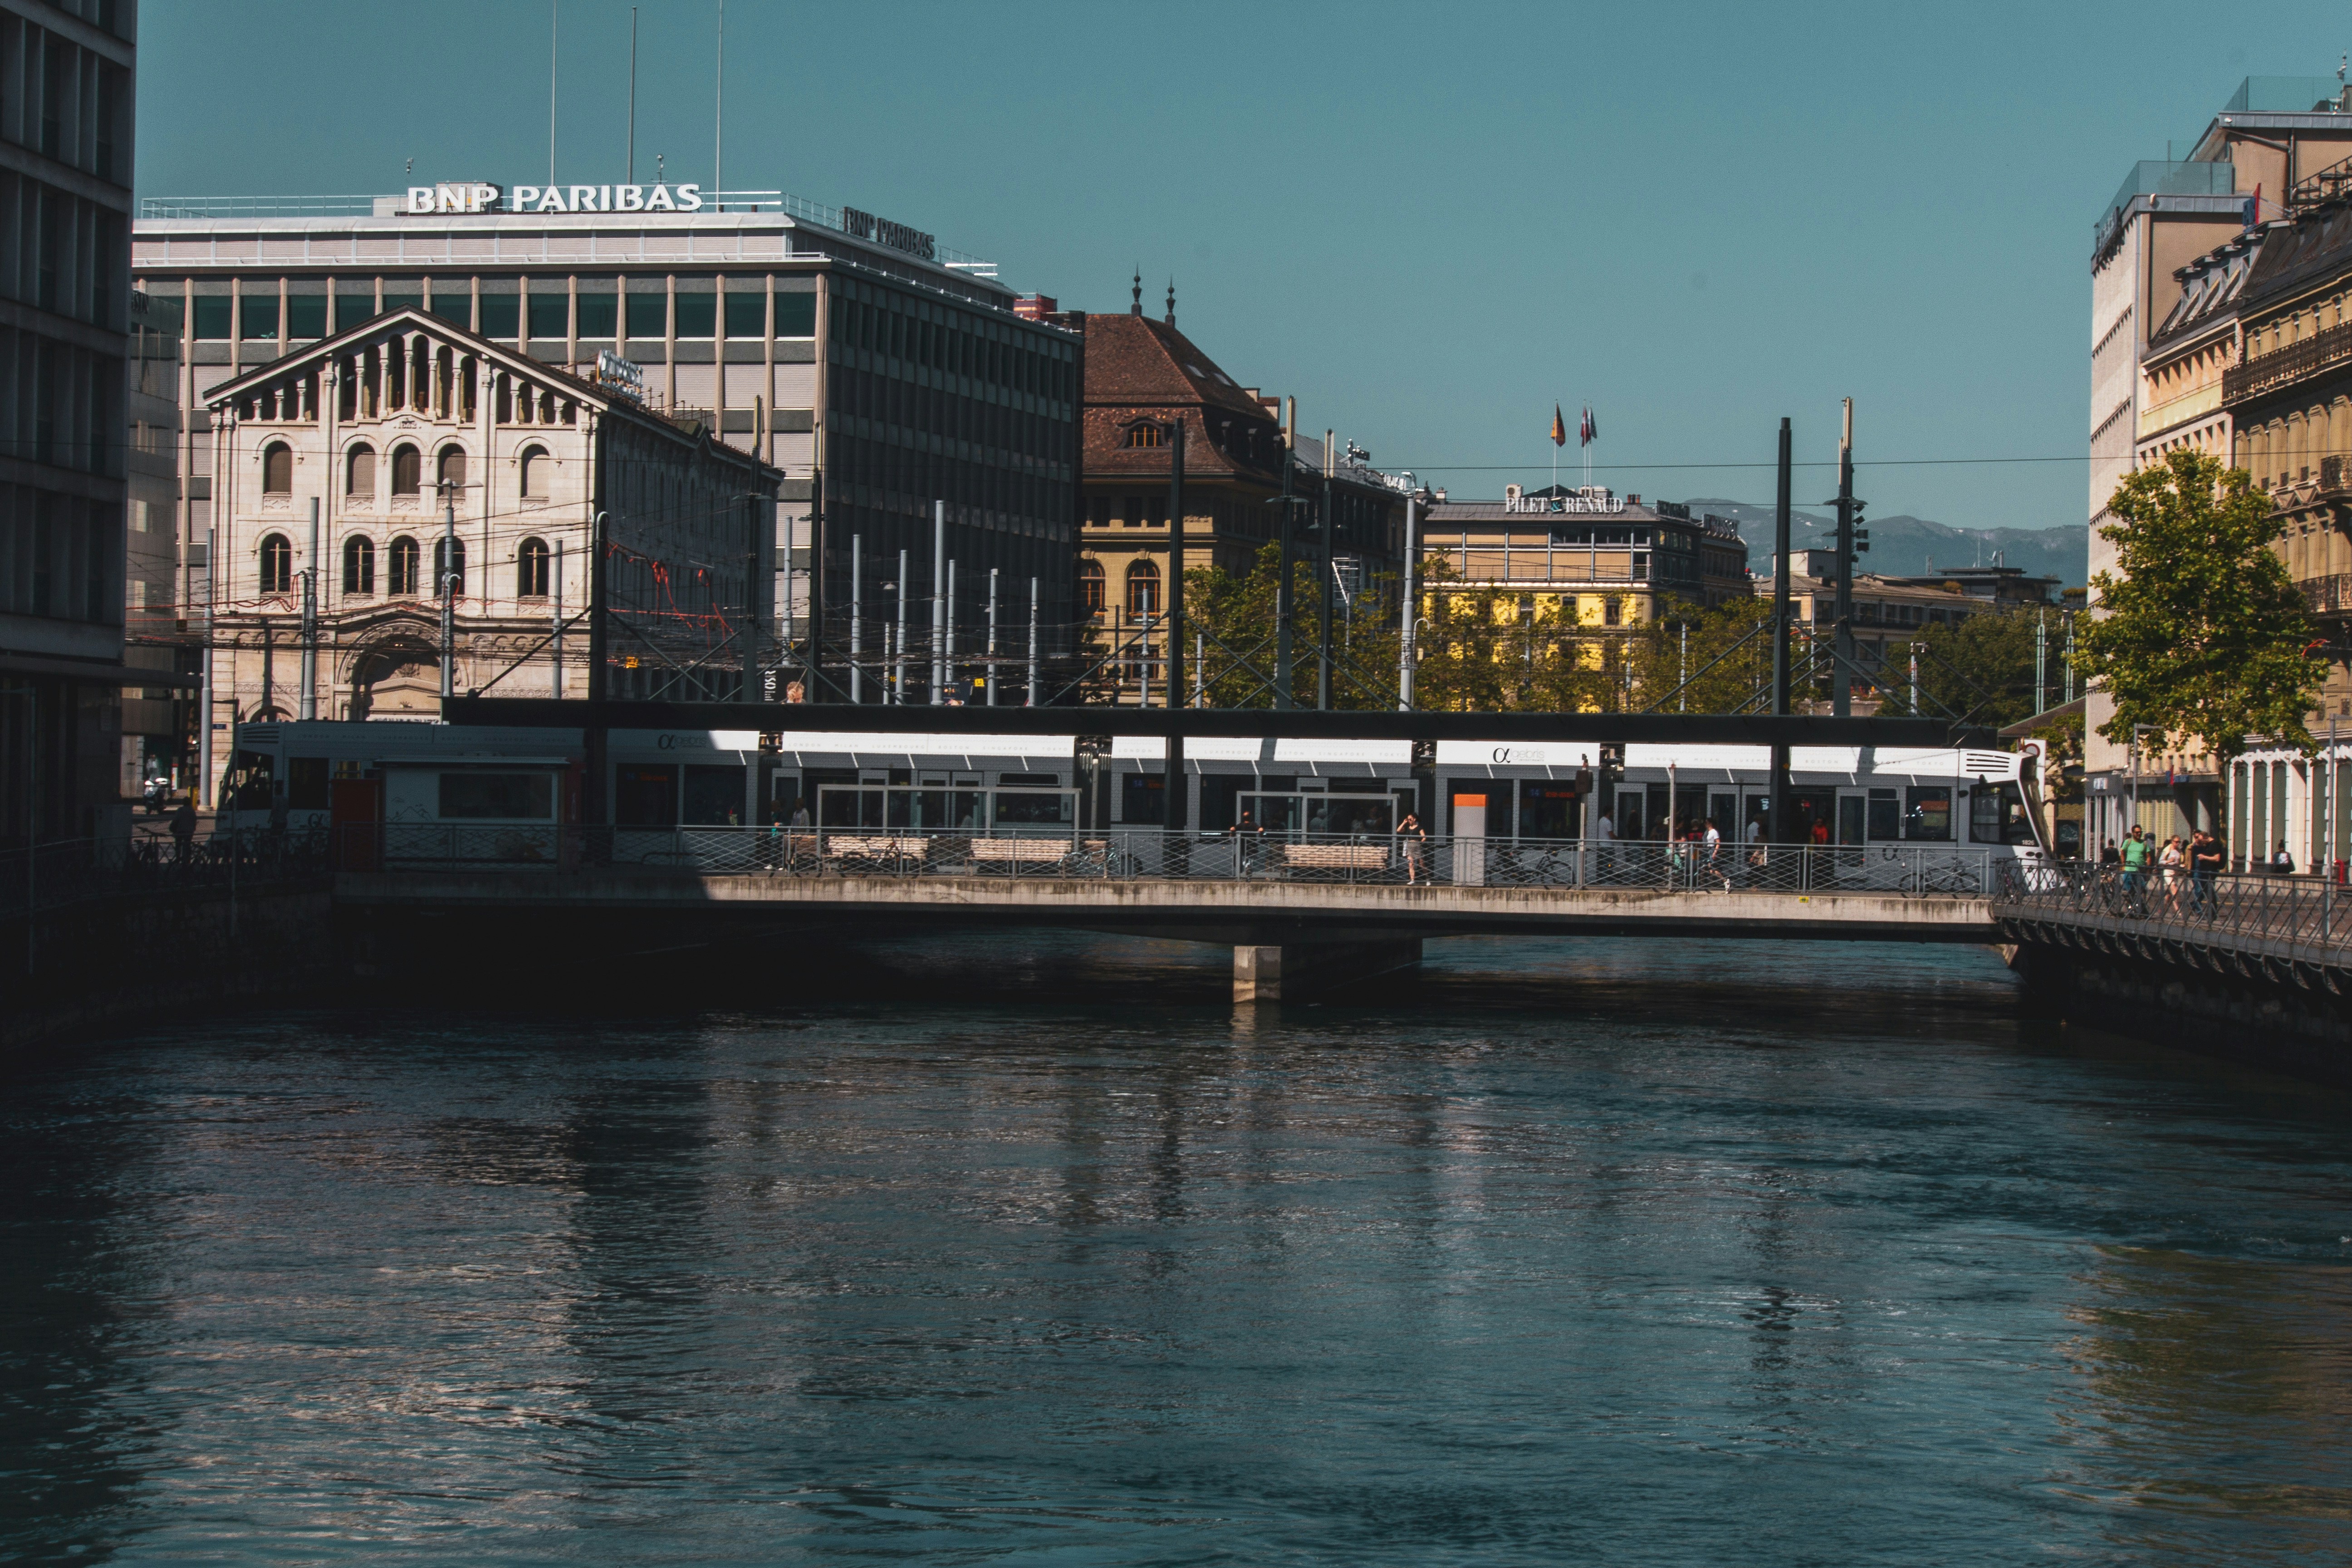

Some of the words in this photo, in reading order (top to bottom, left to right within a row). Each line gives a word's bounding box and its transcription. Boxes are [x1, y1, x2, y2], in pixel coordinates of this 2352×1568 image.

[408, 186, 499, 213] BNP
[513, 184, 702, 212] PARIBAS
[843, 206, 876, 239] BNP
[877, 217, 935, 260] PARIBAS
[1505, 497, 1548, 513] PILET
[1551, 501, 1563, 512] &
[1565, 497, 1624, 513] RENAUD
